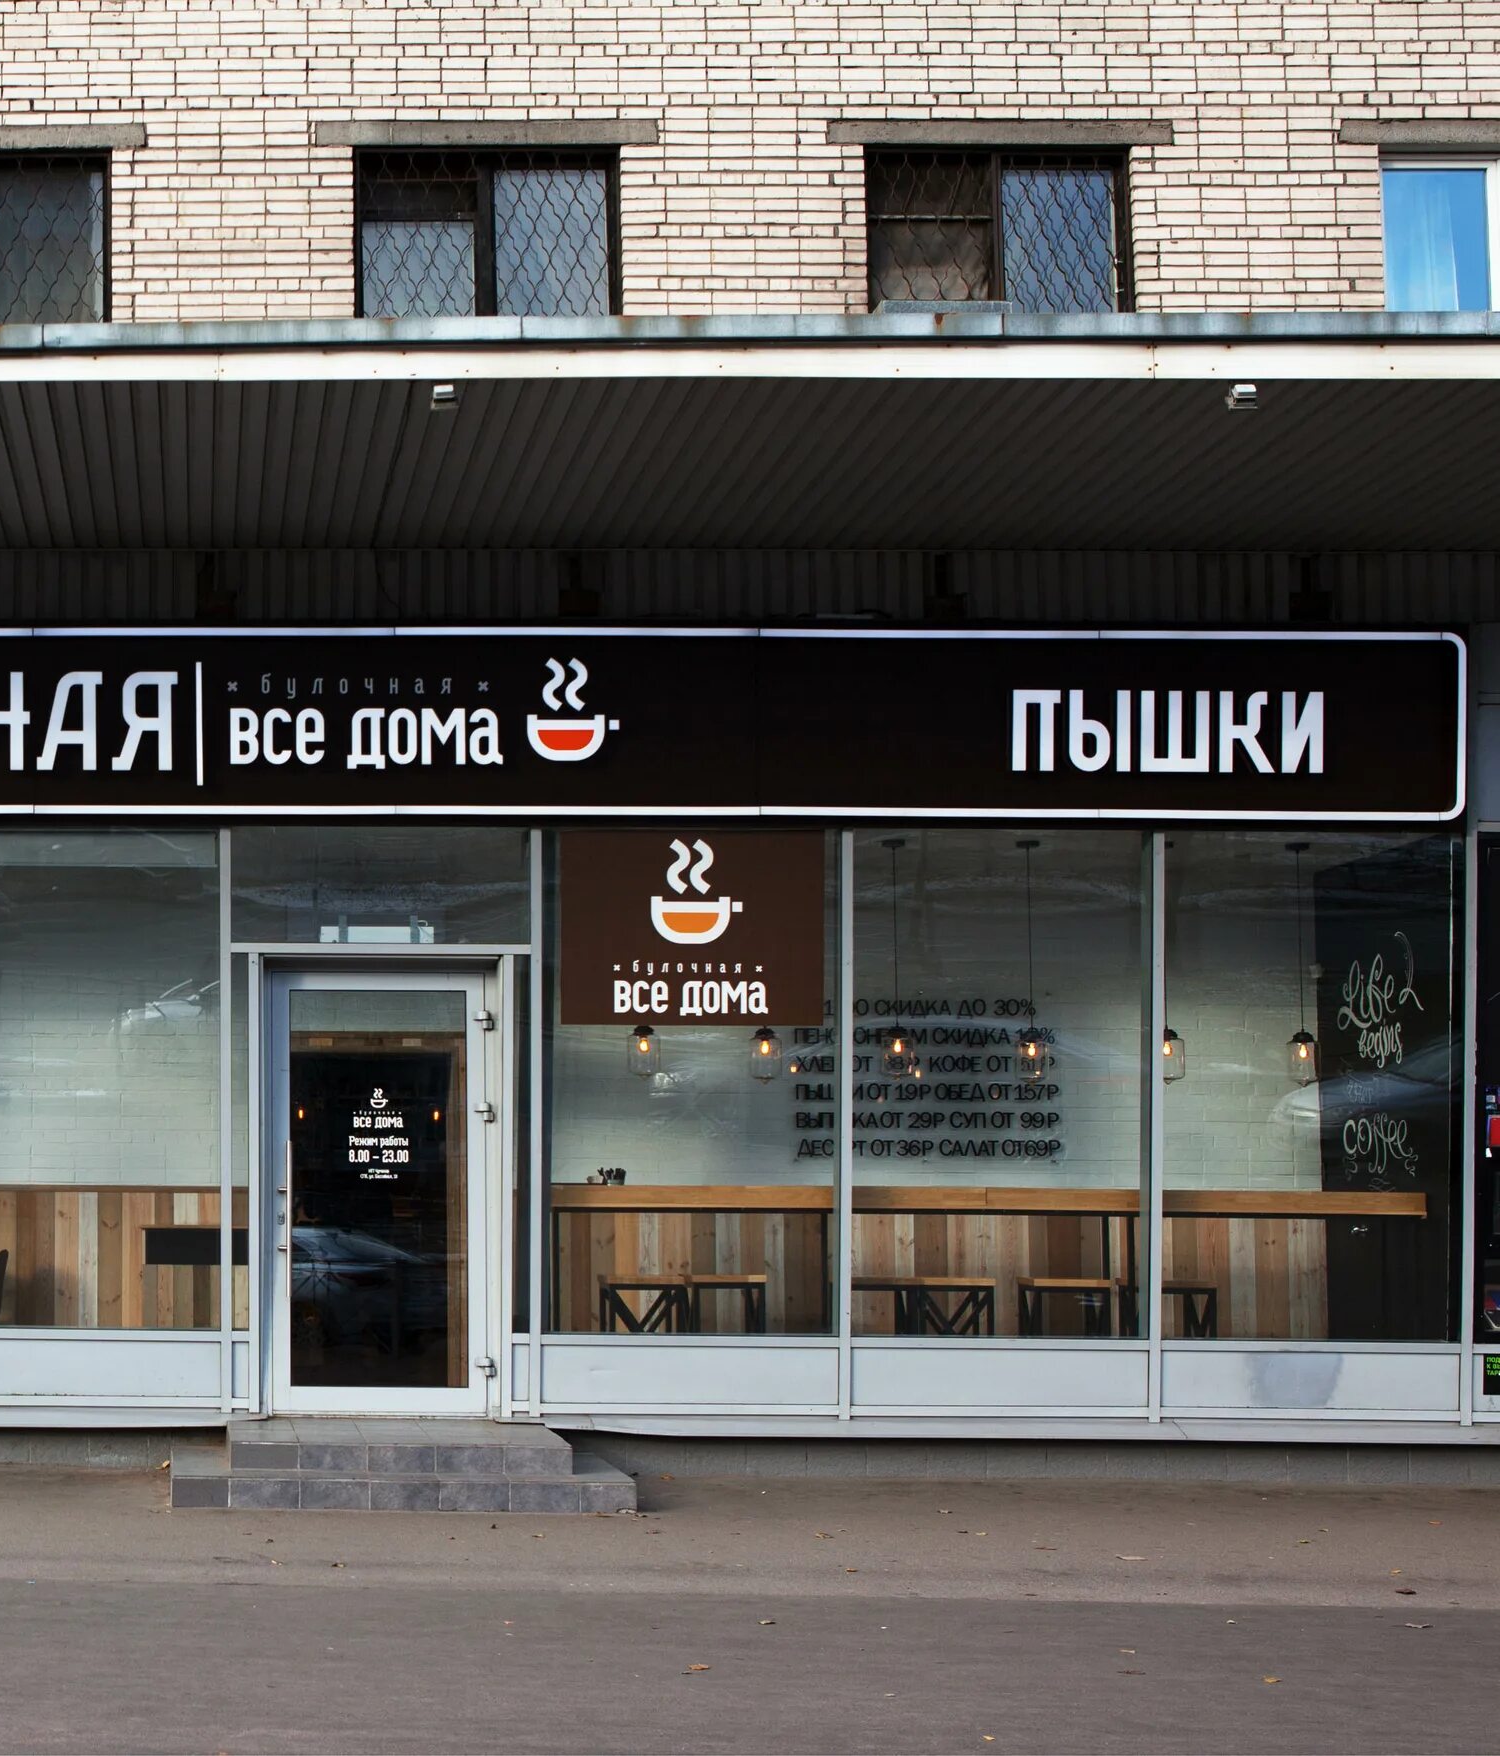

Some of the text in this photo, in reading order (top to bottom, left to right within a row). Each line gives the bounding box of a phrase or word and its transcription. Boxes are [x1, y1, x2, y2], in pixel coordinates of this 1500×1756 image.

[261, 673, 452, 699] булочная
[632, 960, 742, 975] булочная
[1337, 954, 1397, 1030] Life
[874, 999, 951, 1018] СКИДКА
[958, 999, 986, 1019] ДО
[994, 999, 1036, 1016] 30%
[932, 1027, 1010, 1047] СКИДКА
[929, 1055, 982, 1072] КОФЕ
[987, 1055, 1012, 1072] ОТ
[867, 1083, 891, 1100] ОТ
[935, 1083, 985, 1102] ОБЕД
[988, 1083, 1012, 1100] ОТ
[880, 1111, 903, 1128] ОТ
[950, 1112, 986, 1129] СУП
[991, 1111, 1014, 1129] ОТ
[348, 1136, 408, 1148] Режим работы
[870, 1139, 894, 1156] ОТ
[939, 1139, 999, 1156] САЛАТ
[1002, 1139, 1024, 1156] ОТ
[349, 1149, 370, 1162] 8.00
[382, 1149, 408, 1162] 23.00
